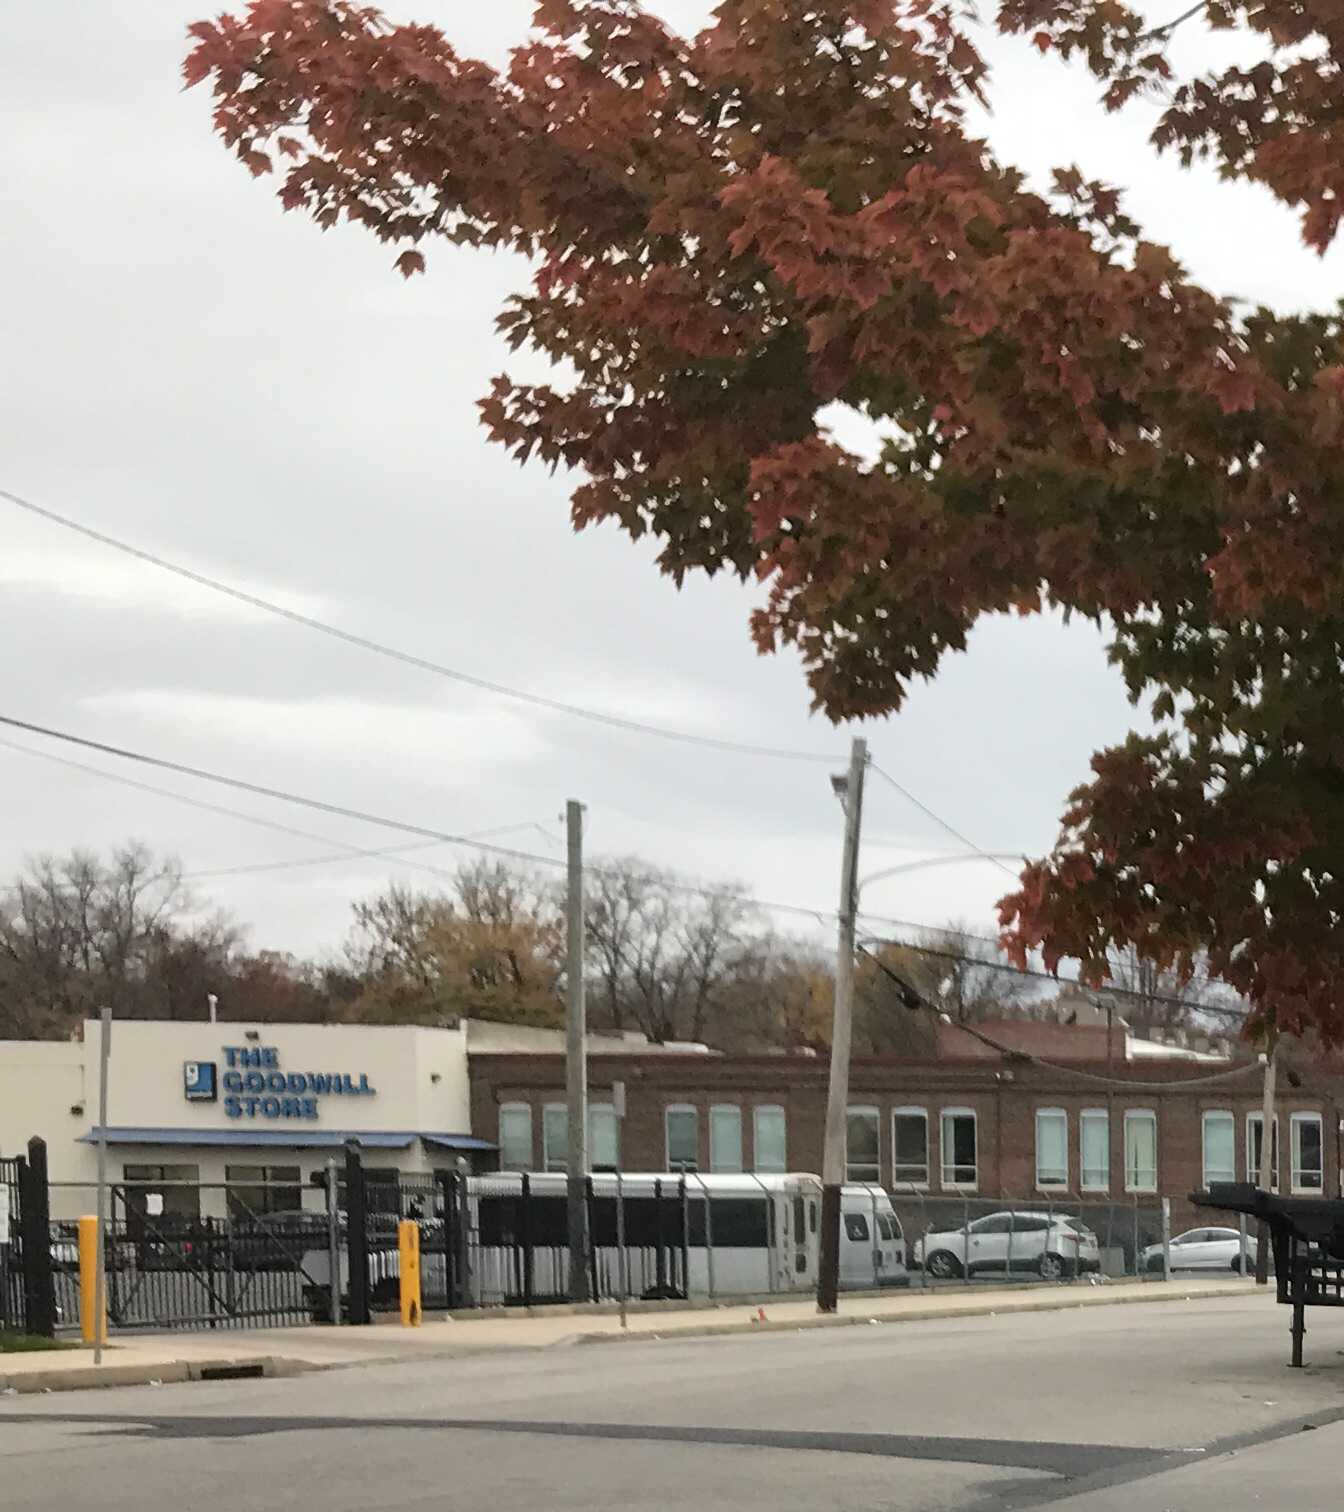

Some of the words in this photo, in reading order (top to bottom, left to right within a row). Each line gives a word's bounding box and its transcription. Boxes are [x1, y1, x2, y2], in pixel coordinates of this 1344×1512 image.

[222, 1045, 279, 1068] THE
[223, 1071, 377, 1096] GOODWILL
[224, 1096, 319, 1120] STORE
